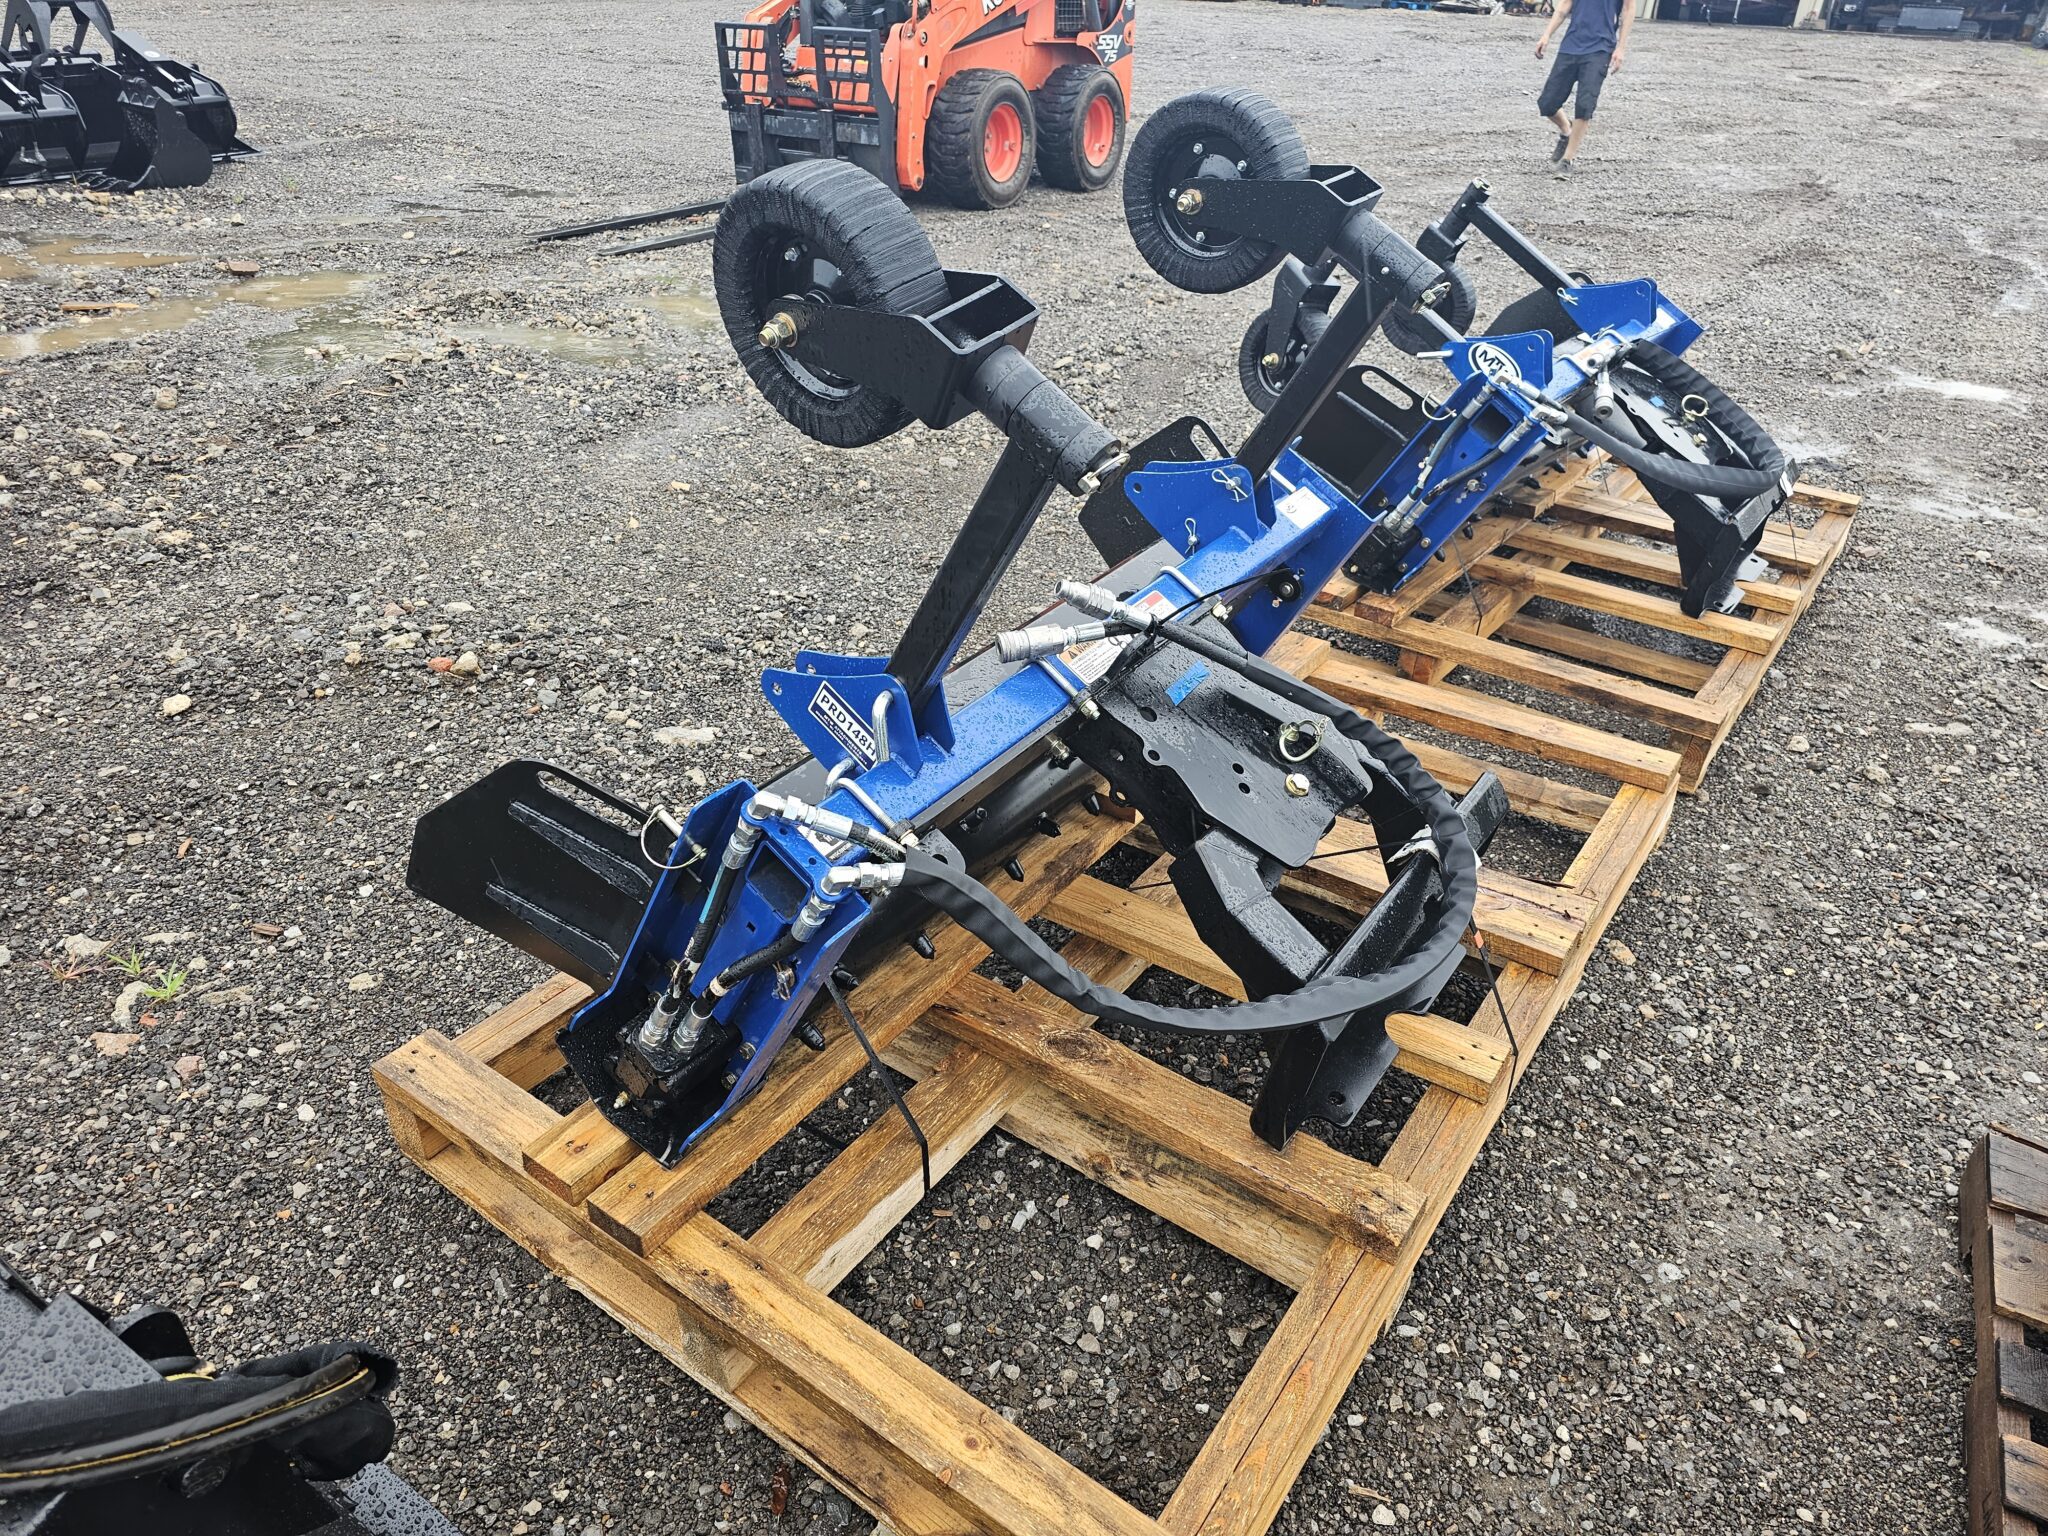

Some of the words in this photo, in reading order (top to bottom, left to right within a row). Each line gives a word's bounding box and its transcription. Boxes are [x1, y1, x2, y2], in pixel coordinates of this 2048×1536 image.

[1097, 34, 1123, 50] SSV
[1103, 49, 1119, 62] 75
[820, 694, 876, 756] PRD148H
